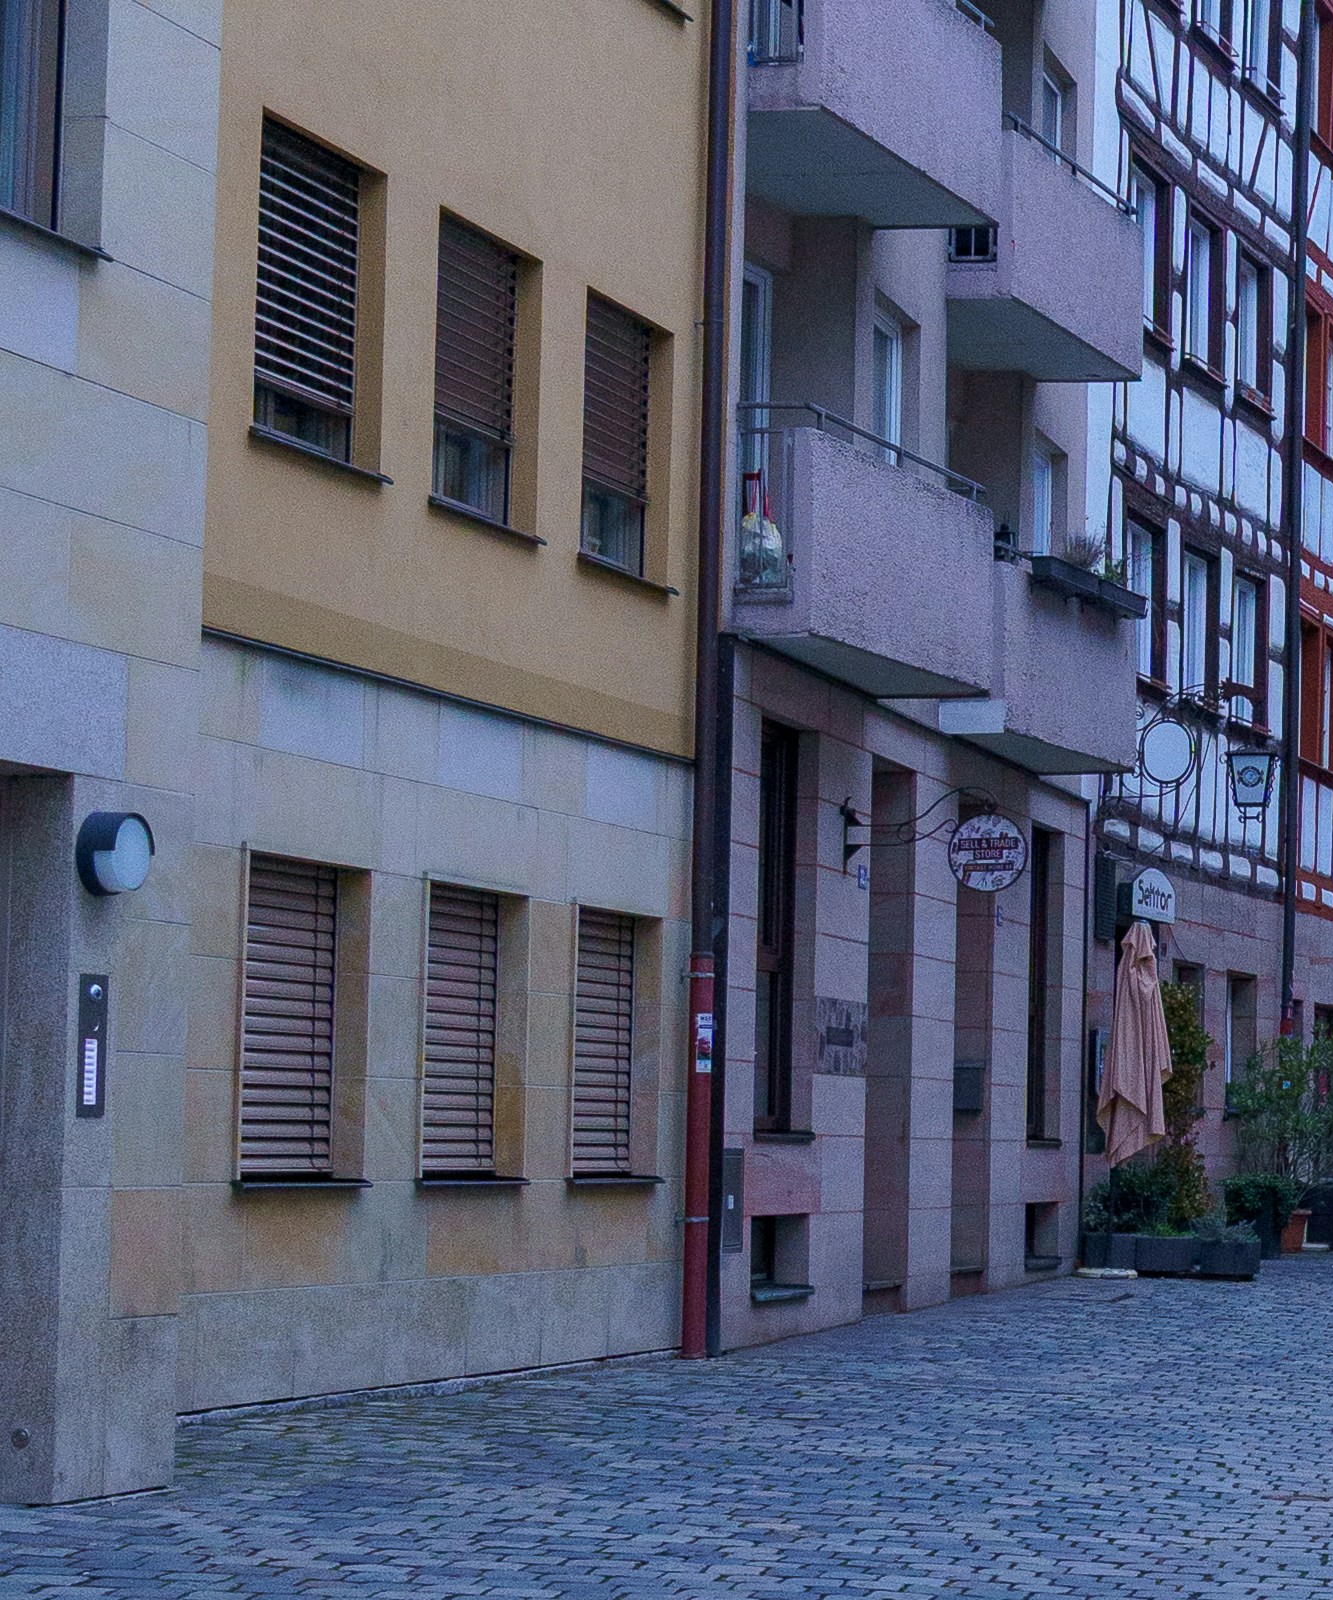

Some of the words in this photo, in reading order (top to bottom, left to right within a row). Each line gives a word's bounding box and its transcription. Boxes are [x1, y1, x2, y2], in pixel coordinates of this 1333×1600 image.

[960, 841, 979, 849] SELL
[990, 839, 1016, 848] TRADE
[974, 850, 1001, 859] STORE
